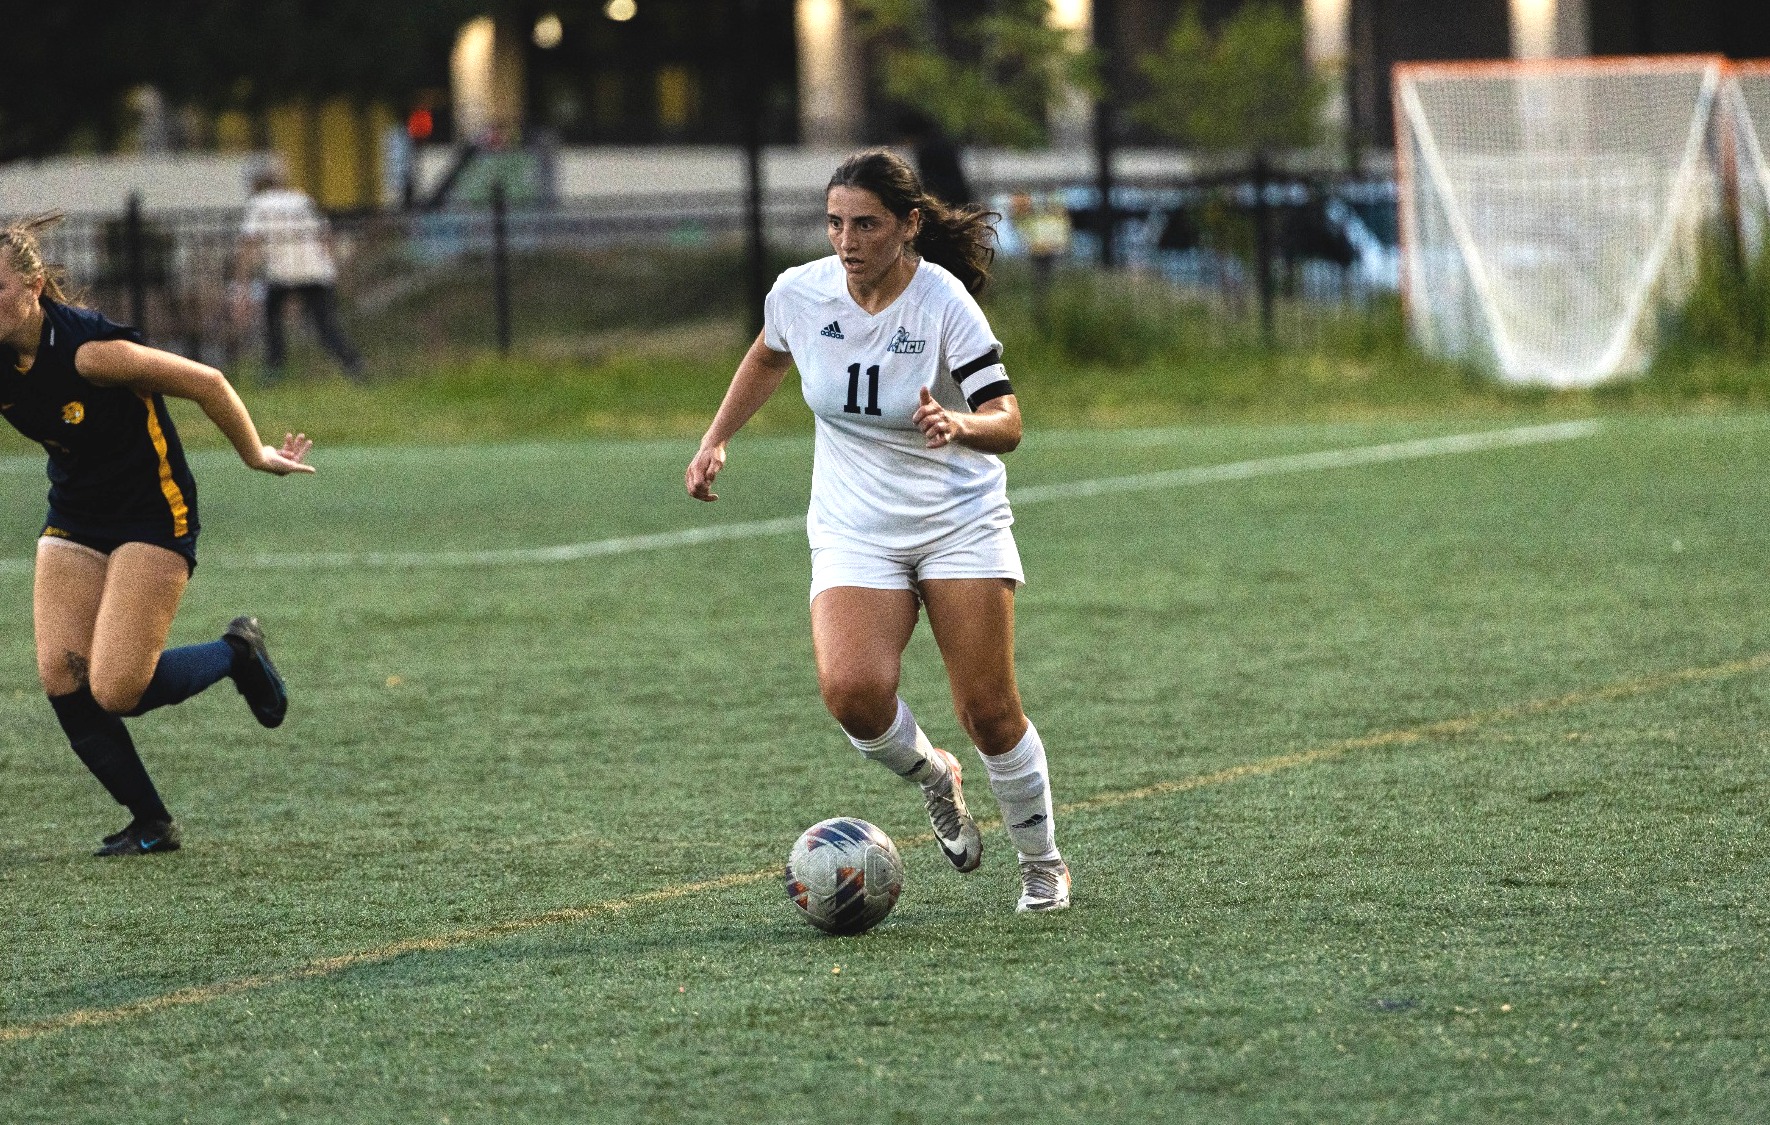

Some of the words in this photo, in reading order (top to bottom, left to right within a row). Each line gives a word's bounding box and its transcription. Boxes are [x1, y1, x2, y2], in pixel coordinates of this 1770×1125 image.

[821, 330, 844, 339] adidas
[895, 340, 925, 353] NCU
[844, 363, 882, 416] 11
